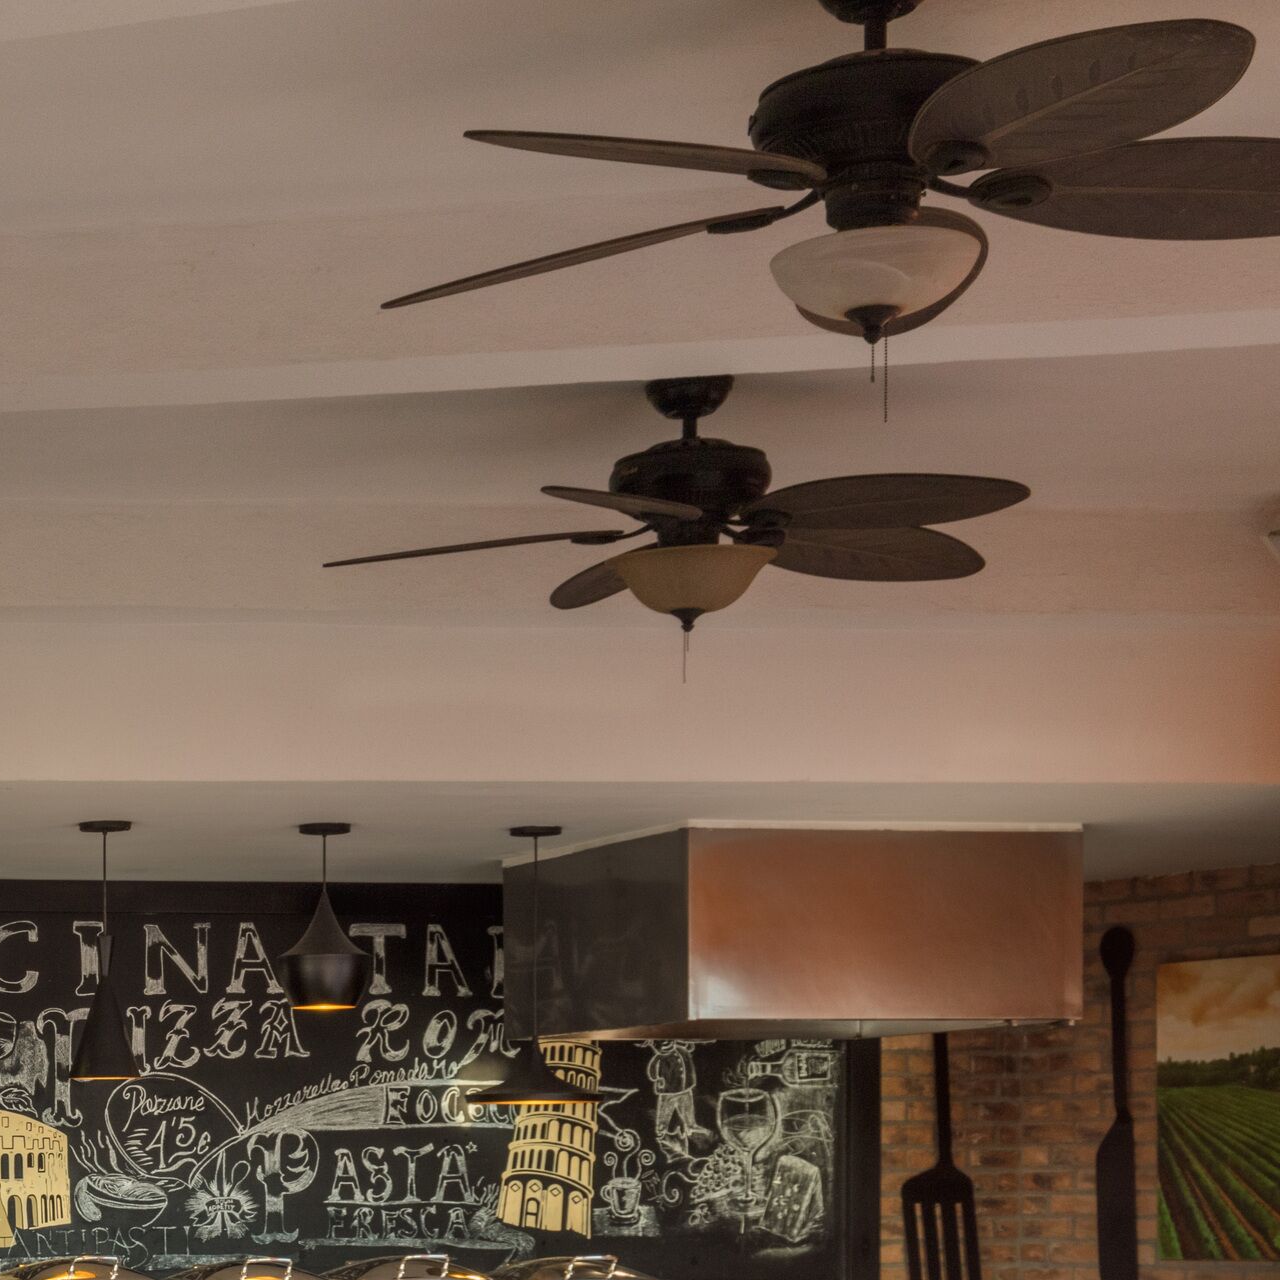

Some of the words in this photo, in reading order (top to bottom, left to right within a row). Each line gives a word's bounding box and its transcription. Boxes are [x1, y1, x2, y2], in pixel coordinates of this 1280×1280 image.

[246, 1130, 476, 1245] PASTA
[326, 1206, 472, 1240] FRESCA
[6, 1225, 191, 1269] ANTIPASTI
